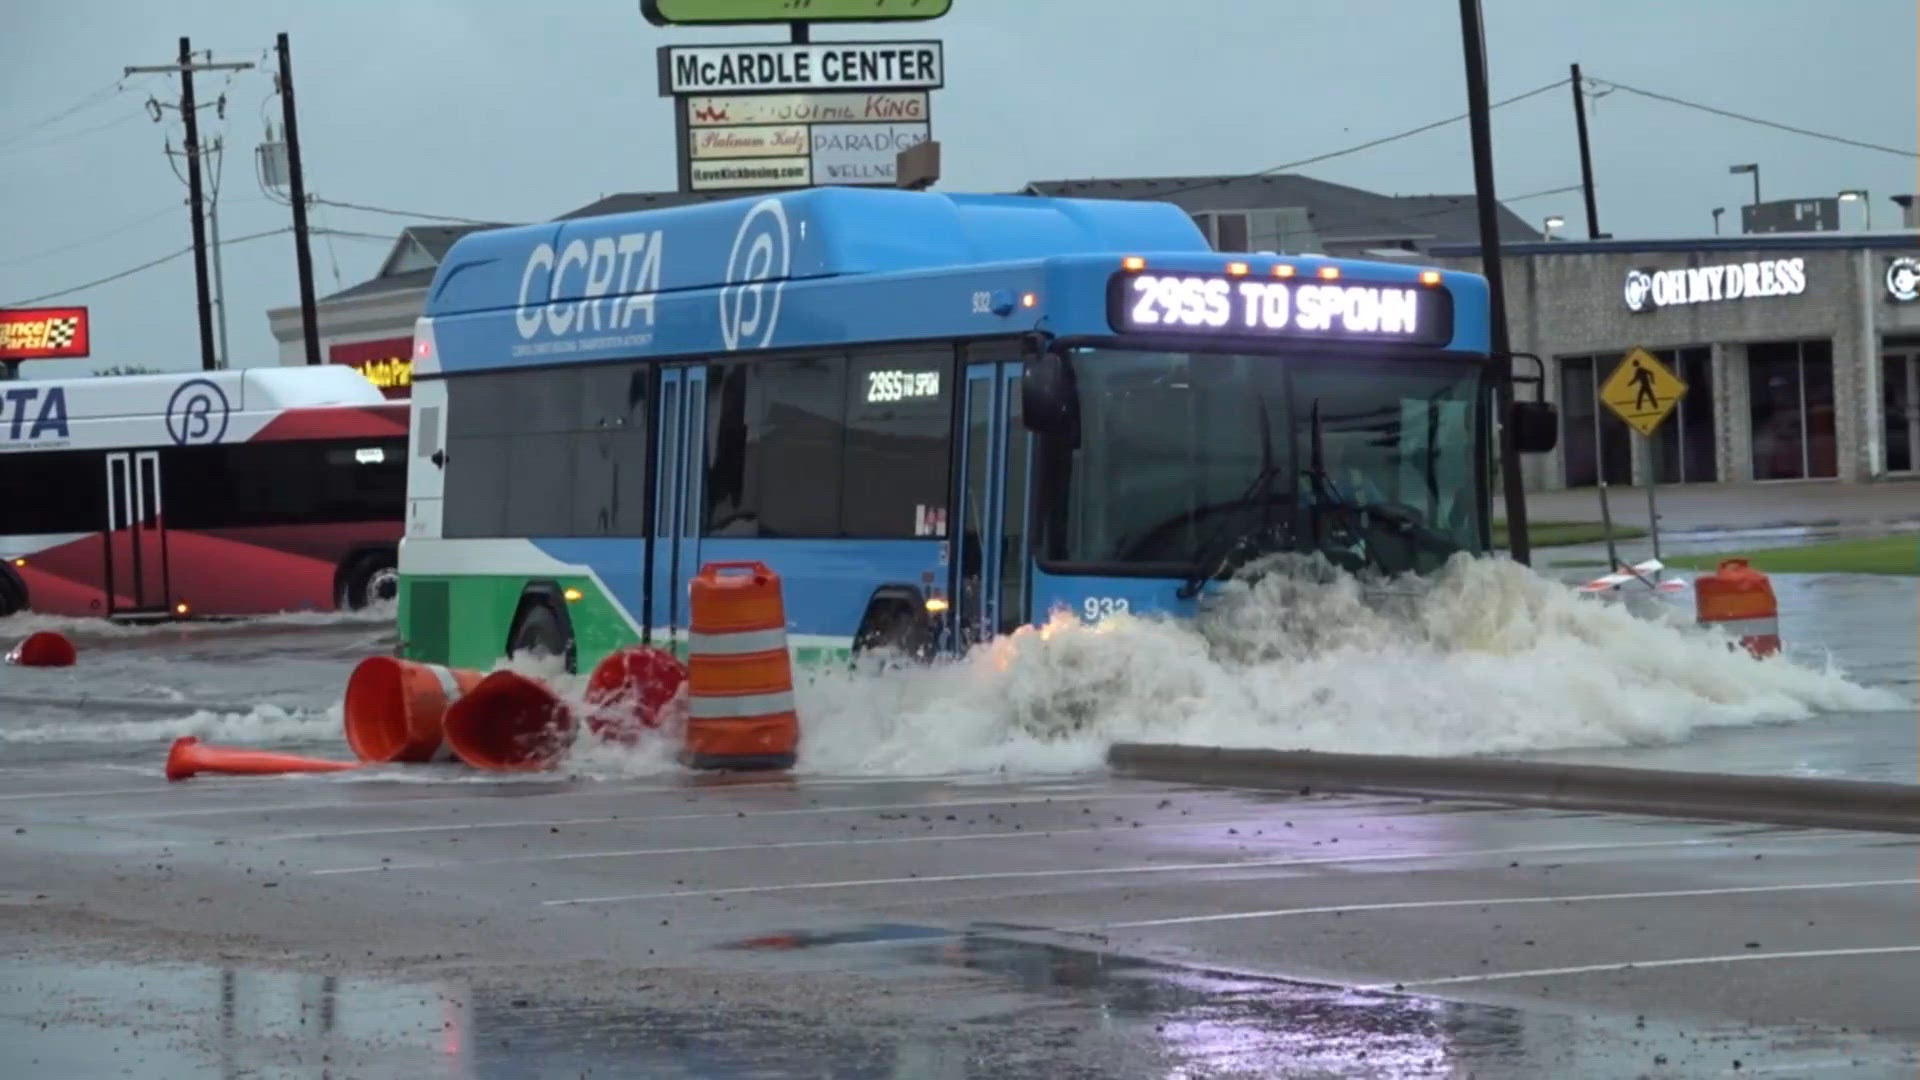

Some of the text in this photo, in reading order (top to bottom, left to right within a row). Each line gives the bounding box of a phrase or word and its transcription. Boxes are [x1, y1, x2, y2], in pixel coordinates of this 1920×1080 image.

[676, 50, 935, 86] McARDLE CENTER
[701, 131, 764, 149] Platinum
[516, 230, 663, 339] CCRTA
[1132, 275, 1417, 333] 29SS TO SPOHN
[1652, 257, 1805, 306] OH MY DRESS
[868, 370, 902, 402] 29SS
[0, 386, 70, 440] TA
